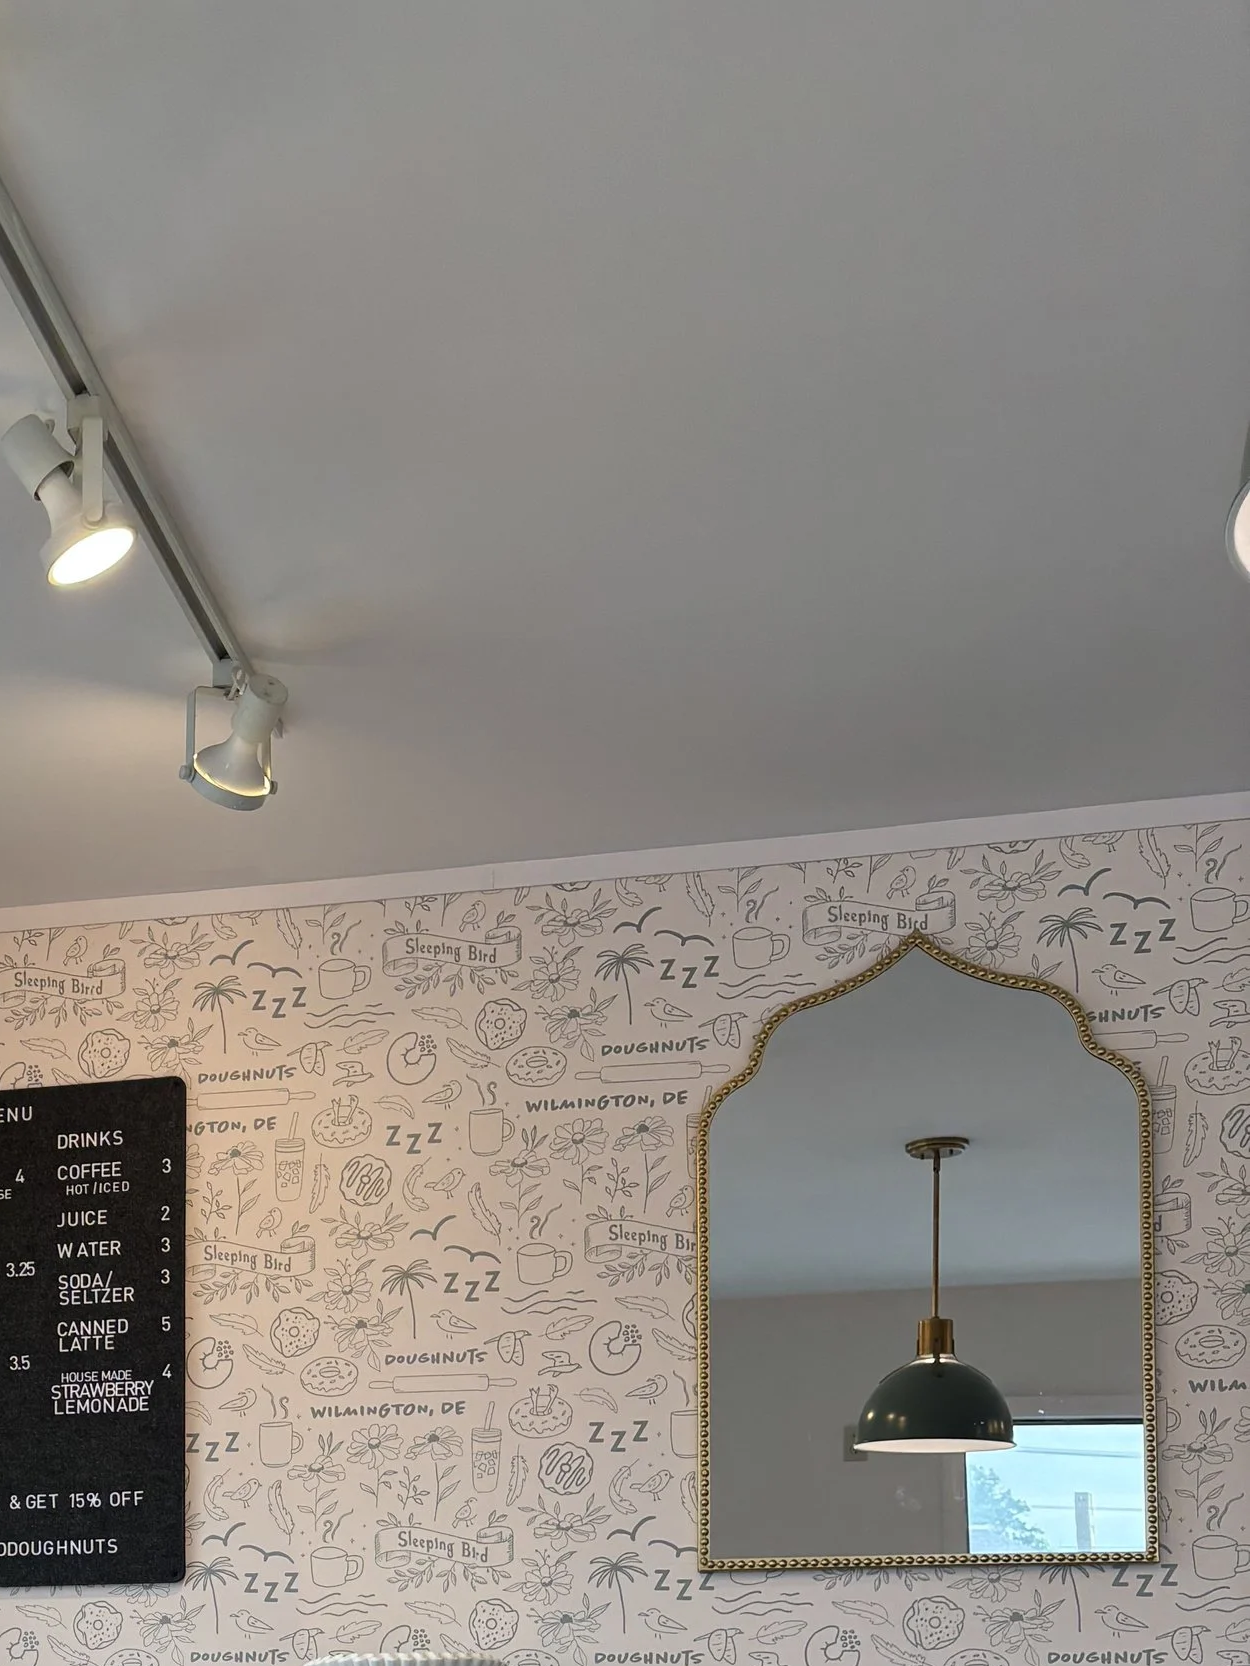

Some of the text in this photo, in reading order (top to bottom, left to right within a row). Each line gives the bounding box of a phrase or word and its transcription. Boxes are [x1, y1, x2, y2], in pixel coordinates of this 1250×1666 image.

[827, 905, 929, 932] Sleeping Bird
[405, 937, 498, 964] Sleeping Bird
[14, 970, 66, 995] Sleeping
[601, 1038, 710, 1057] DOUGHNUTS
[197, 1064, 298, 1084] DOUGHNUTS
[662, 1090, 689, 1107] DE
[253, 1116, 277, 1131] DE
[56, 1130, 124, 1149] DRINKS
[15, 1169, 25, 1184] 4
[57, 1158, 172, 1180] COFFEE 3
[65, 1183, 90, 1196] HOT
[57, 1206, 171, 1228] JUICE 2
[609, 1224, 697, 1252] Sleeping Bir
[57, 1238, 171, 1259] WATER 3
[203, 1244, 291, 1273] Sleeping Bird
[6, 1261, 36, 1278] 3.25
[58, 1270, 170, 1290] SODA/ 3
[59, 1287, 135, 1306] SELTZER
[57, 1316, 171, 1337] CANNED 5
[59, 1335, 115, 1353] LATTE
[9, 1355, 31, 1371] 3.5
[384, 1349, 489, 1367] DOUGHNUTS
[61, 1364, 172, 1383] HOUSE MADE 4
[51, 1380, 155, 1399] STRAWBERRY
[54, 1396, 150, 1415] LEMONADE
[441, 1400, 467, 1417] DE
[9, 1495, 21, 1510] &
[25, 1493, 59, 1510] GET
[69, 1492, 101, 1509] 15%
[109, 1490, 145, 1507] OFF
[397, 1530, 489, 1564] Sleeping Bird
[189, 1649, 290, 1666] DOUGHNUTS
[594, 1650, 706, 1666] DOUGHNUTS
[1047, 1649, 1169, 1666] DOUGHNUTS
